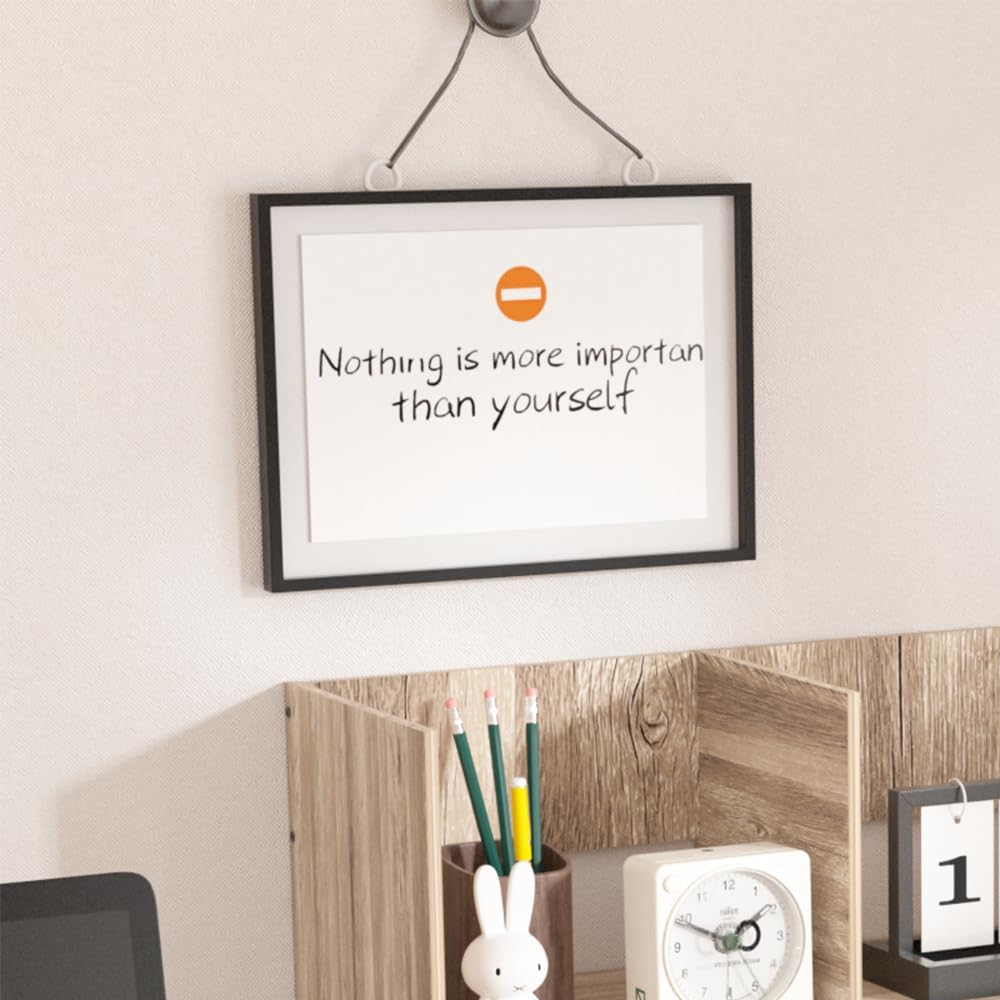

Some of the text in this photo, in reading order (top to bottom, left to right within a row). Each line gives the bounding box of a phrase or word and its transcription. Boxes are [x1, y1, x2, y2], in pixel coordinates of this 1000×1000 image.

[318, 346, 444, 387] Nothing
[457, 346, 480, 370] is
[492, 345, 565, 370] more
[392, 366, 639, 431] than yourself
[722, 879, 736, 891] 12
[938, 855, 981, 906] 1
[776, 930, 784, 941] 3
[674, 942, 681, 953] 9
[752, 980, 759, 992] 5
